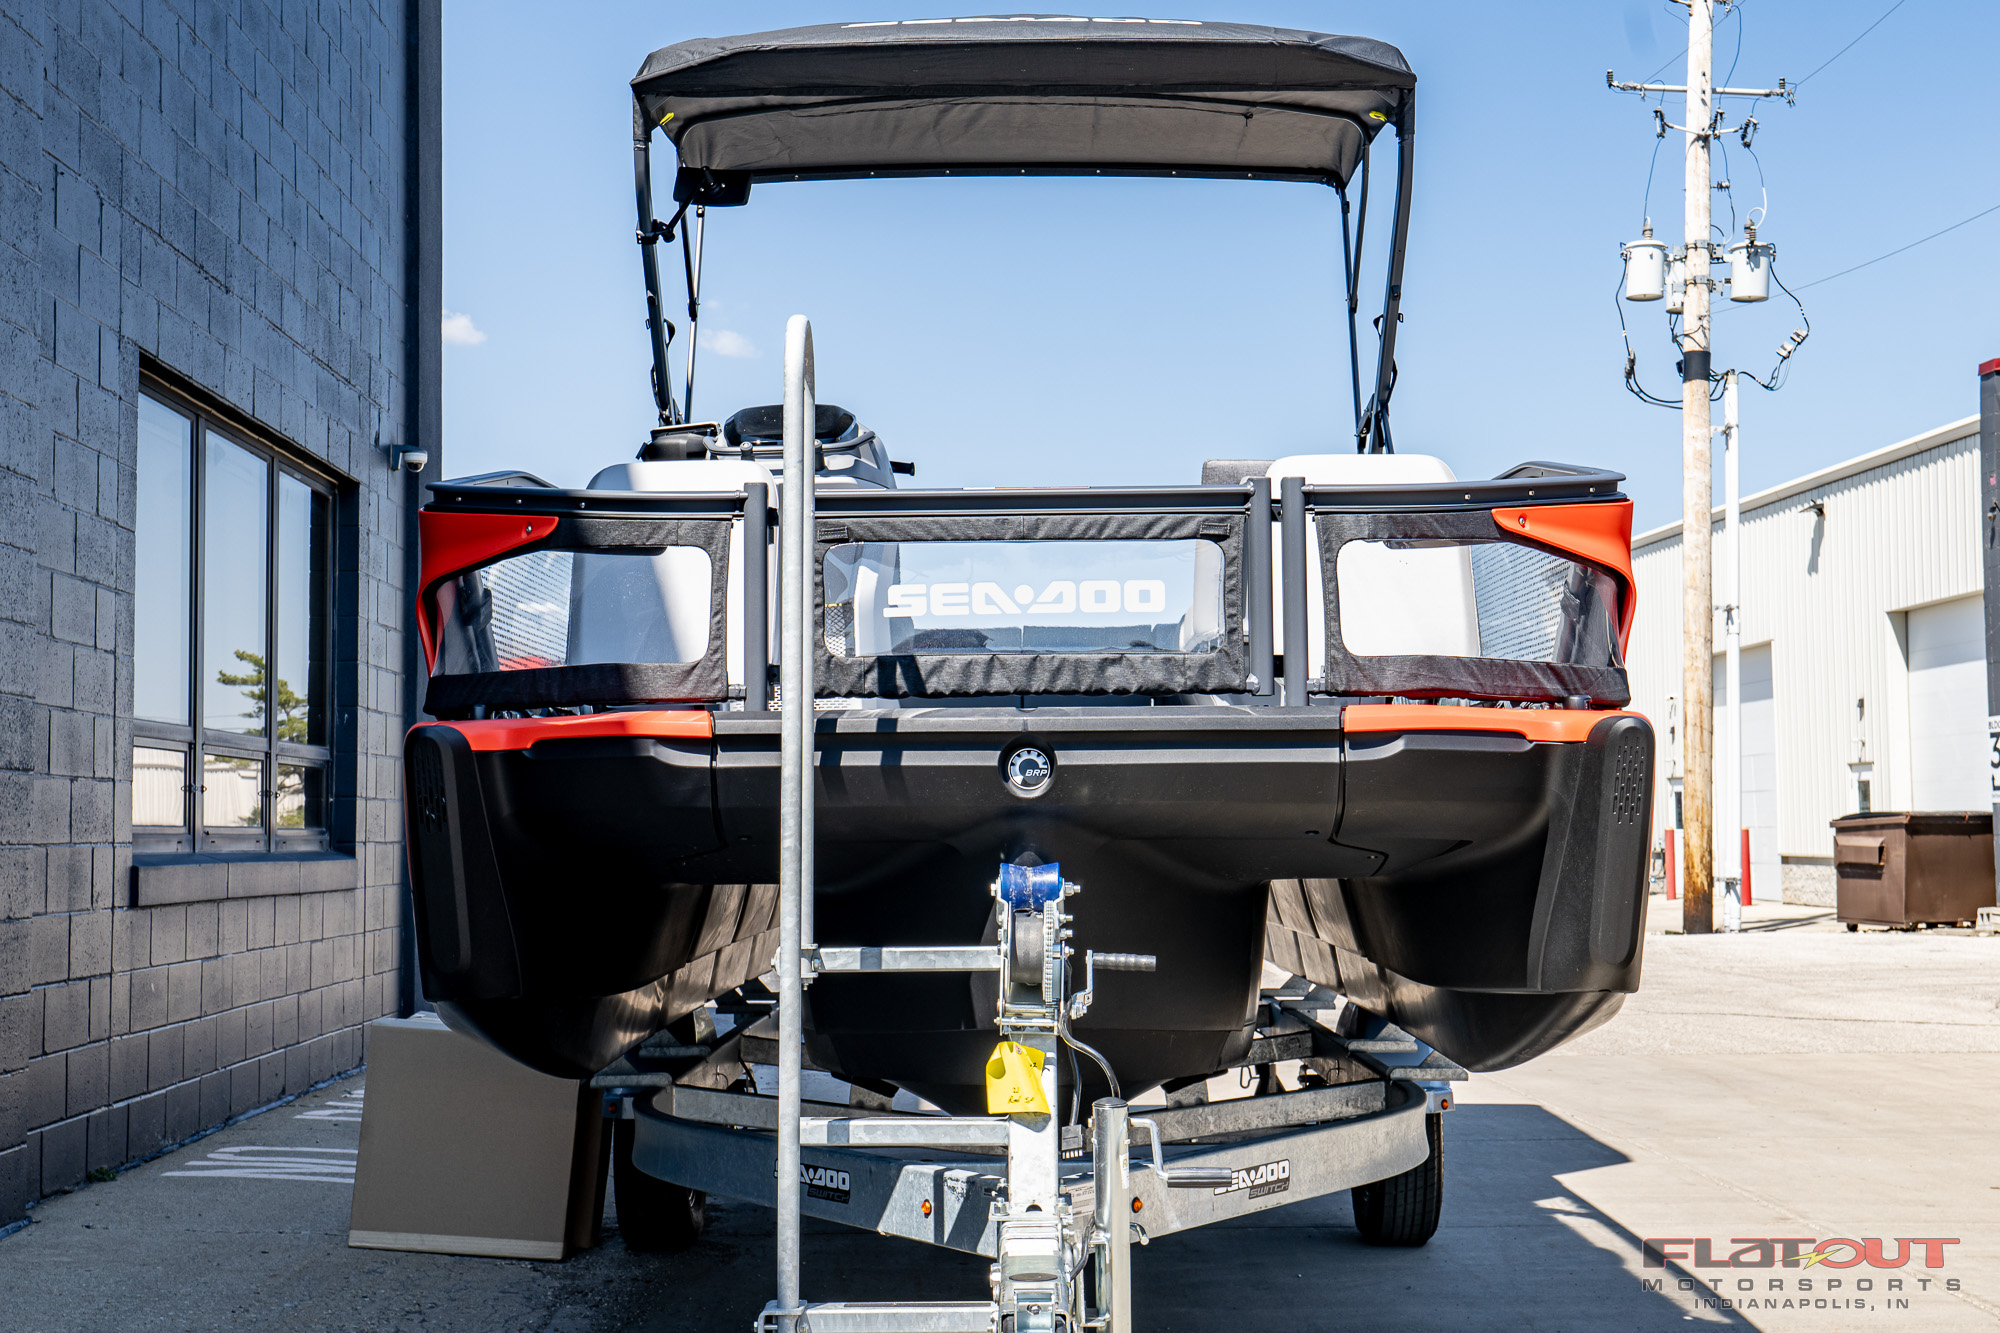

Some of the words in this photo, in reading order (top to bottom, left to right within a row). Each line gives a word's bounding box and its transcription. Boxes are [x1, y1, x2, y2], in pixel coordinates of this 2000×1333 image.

[1025, 769, 1047, 777] BRP
[808, 1187, 850, 1202] SWITCH
[1249, 1180, 1289, 1199] SWITCH
